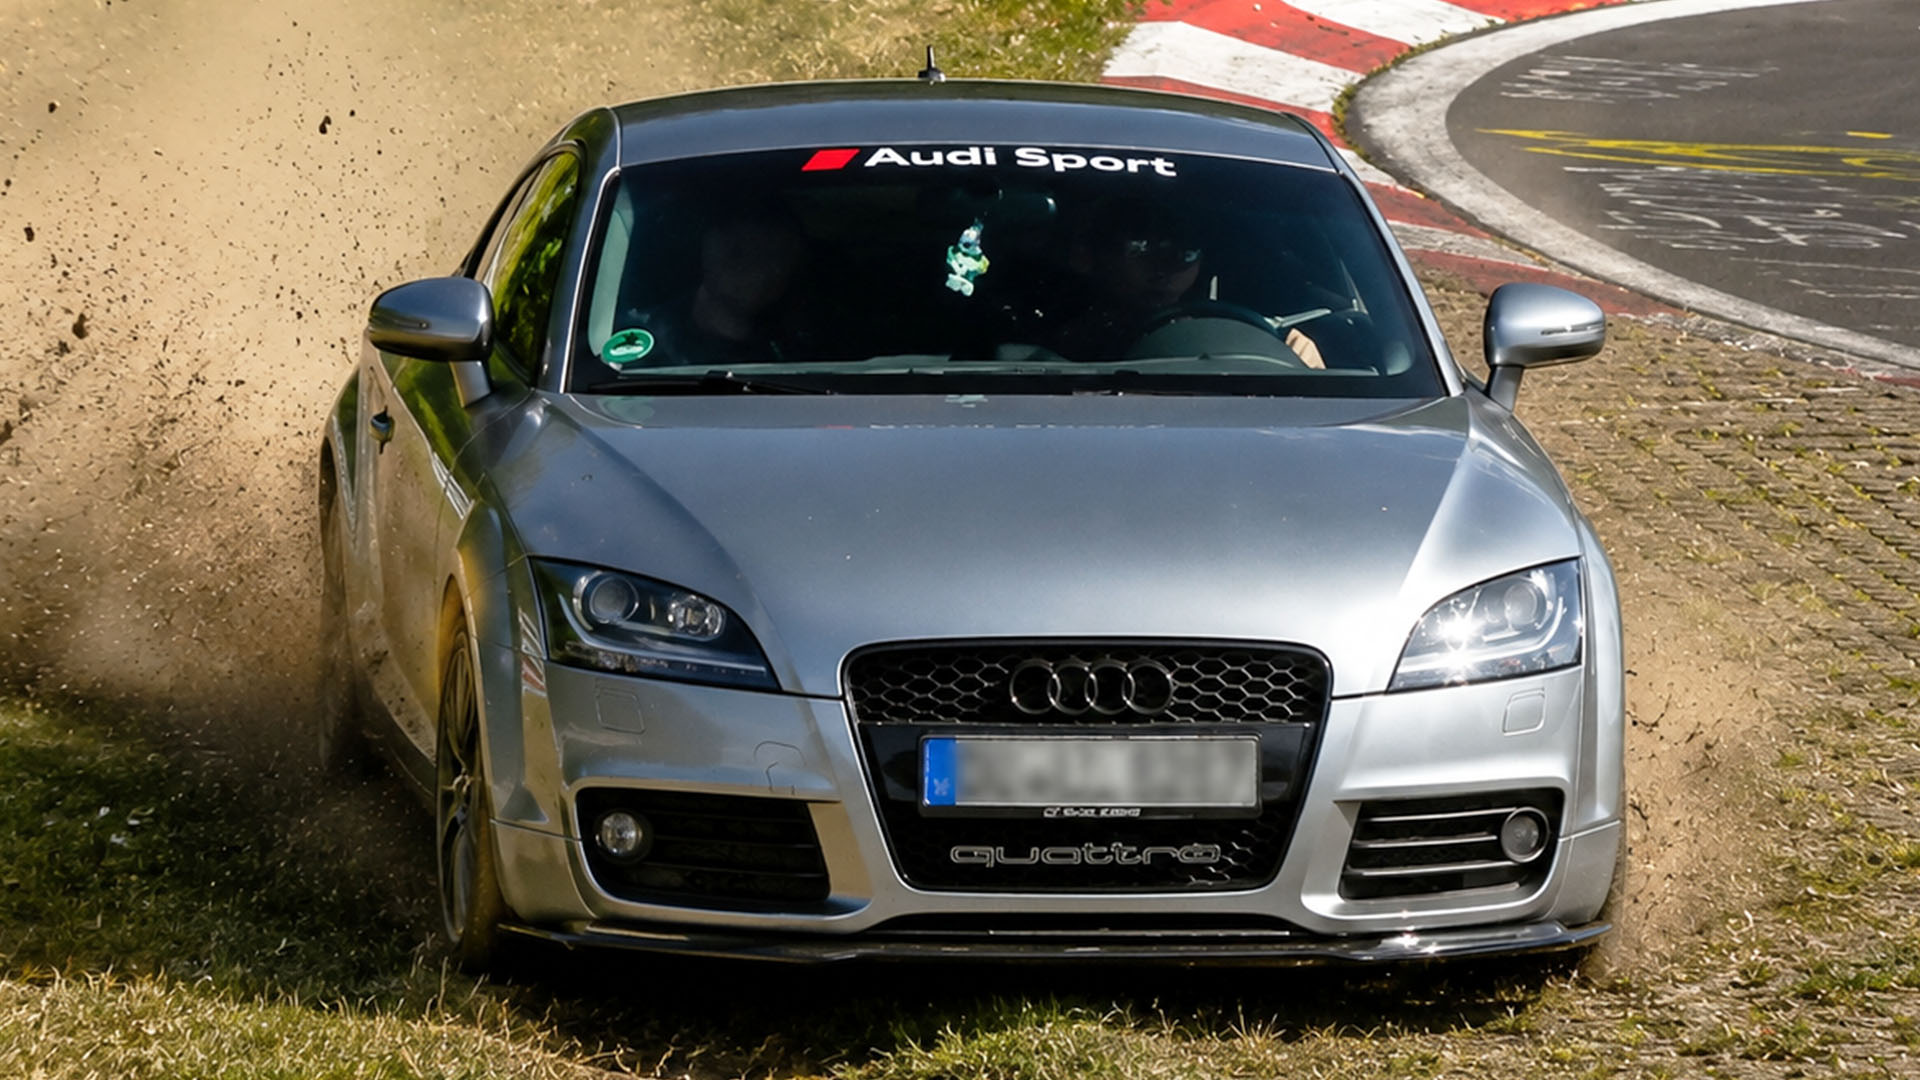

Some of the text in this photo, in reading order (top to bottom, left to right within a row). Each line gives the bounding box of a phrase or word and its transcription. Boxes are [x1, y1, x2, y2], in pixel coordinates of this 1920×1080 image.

[863, 146, 1178, 178] Audi Sport
[950, 843, 1221, 868] quattro
